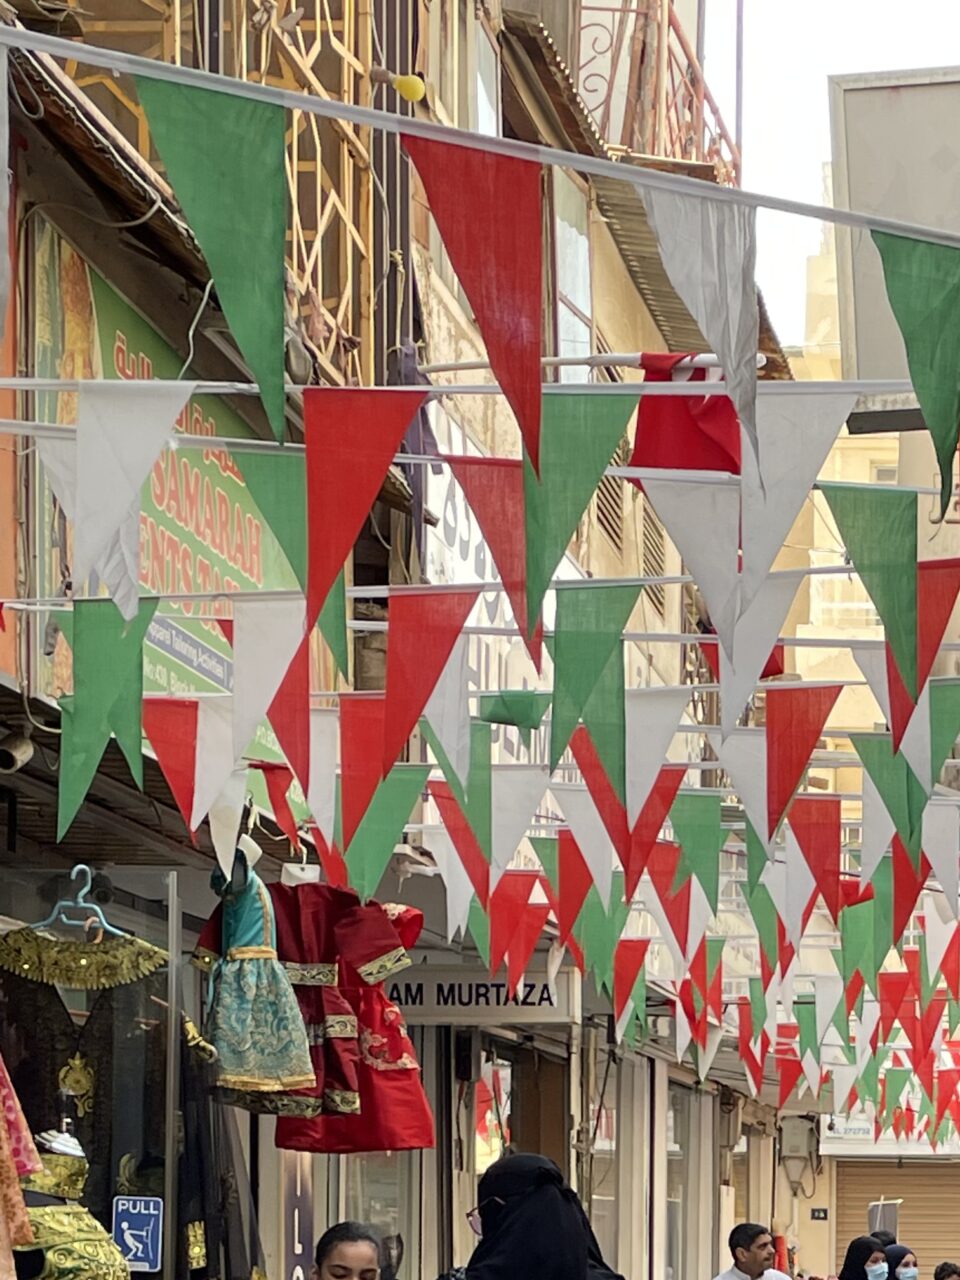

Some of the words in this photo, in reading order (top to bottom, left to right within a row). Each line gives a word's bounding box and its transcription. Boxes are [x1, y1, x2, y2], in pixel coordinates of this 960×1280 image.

[150, 446, 264, 589] SAMARAH
[436, 982, 554, 1007] MURTAZA
[117, 1200, 159, 1215] PULL
